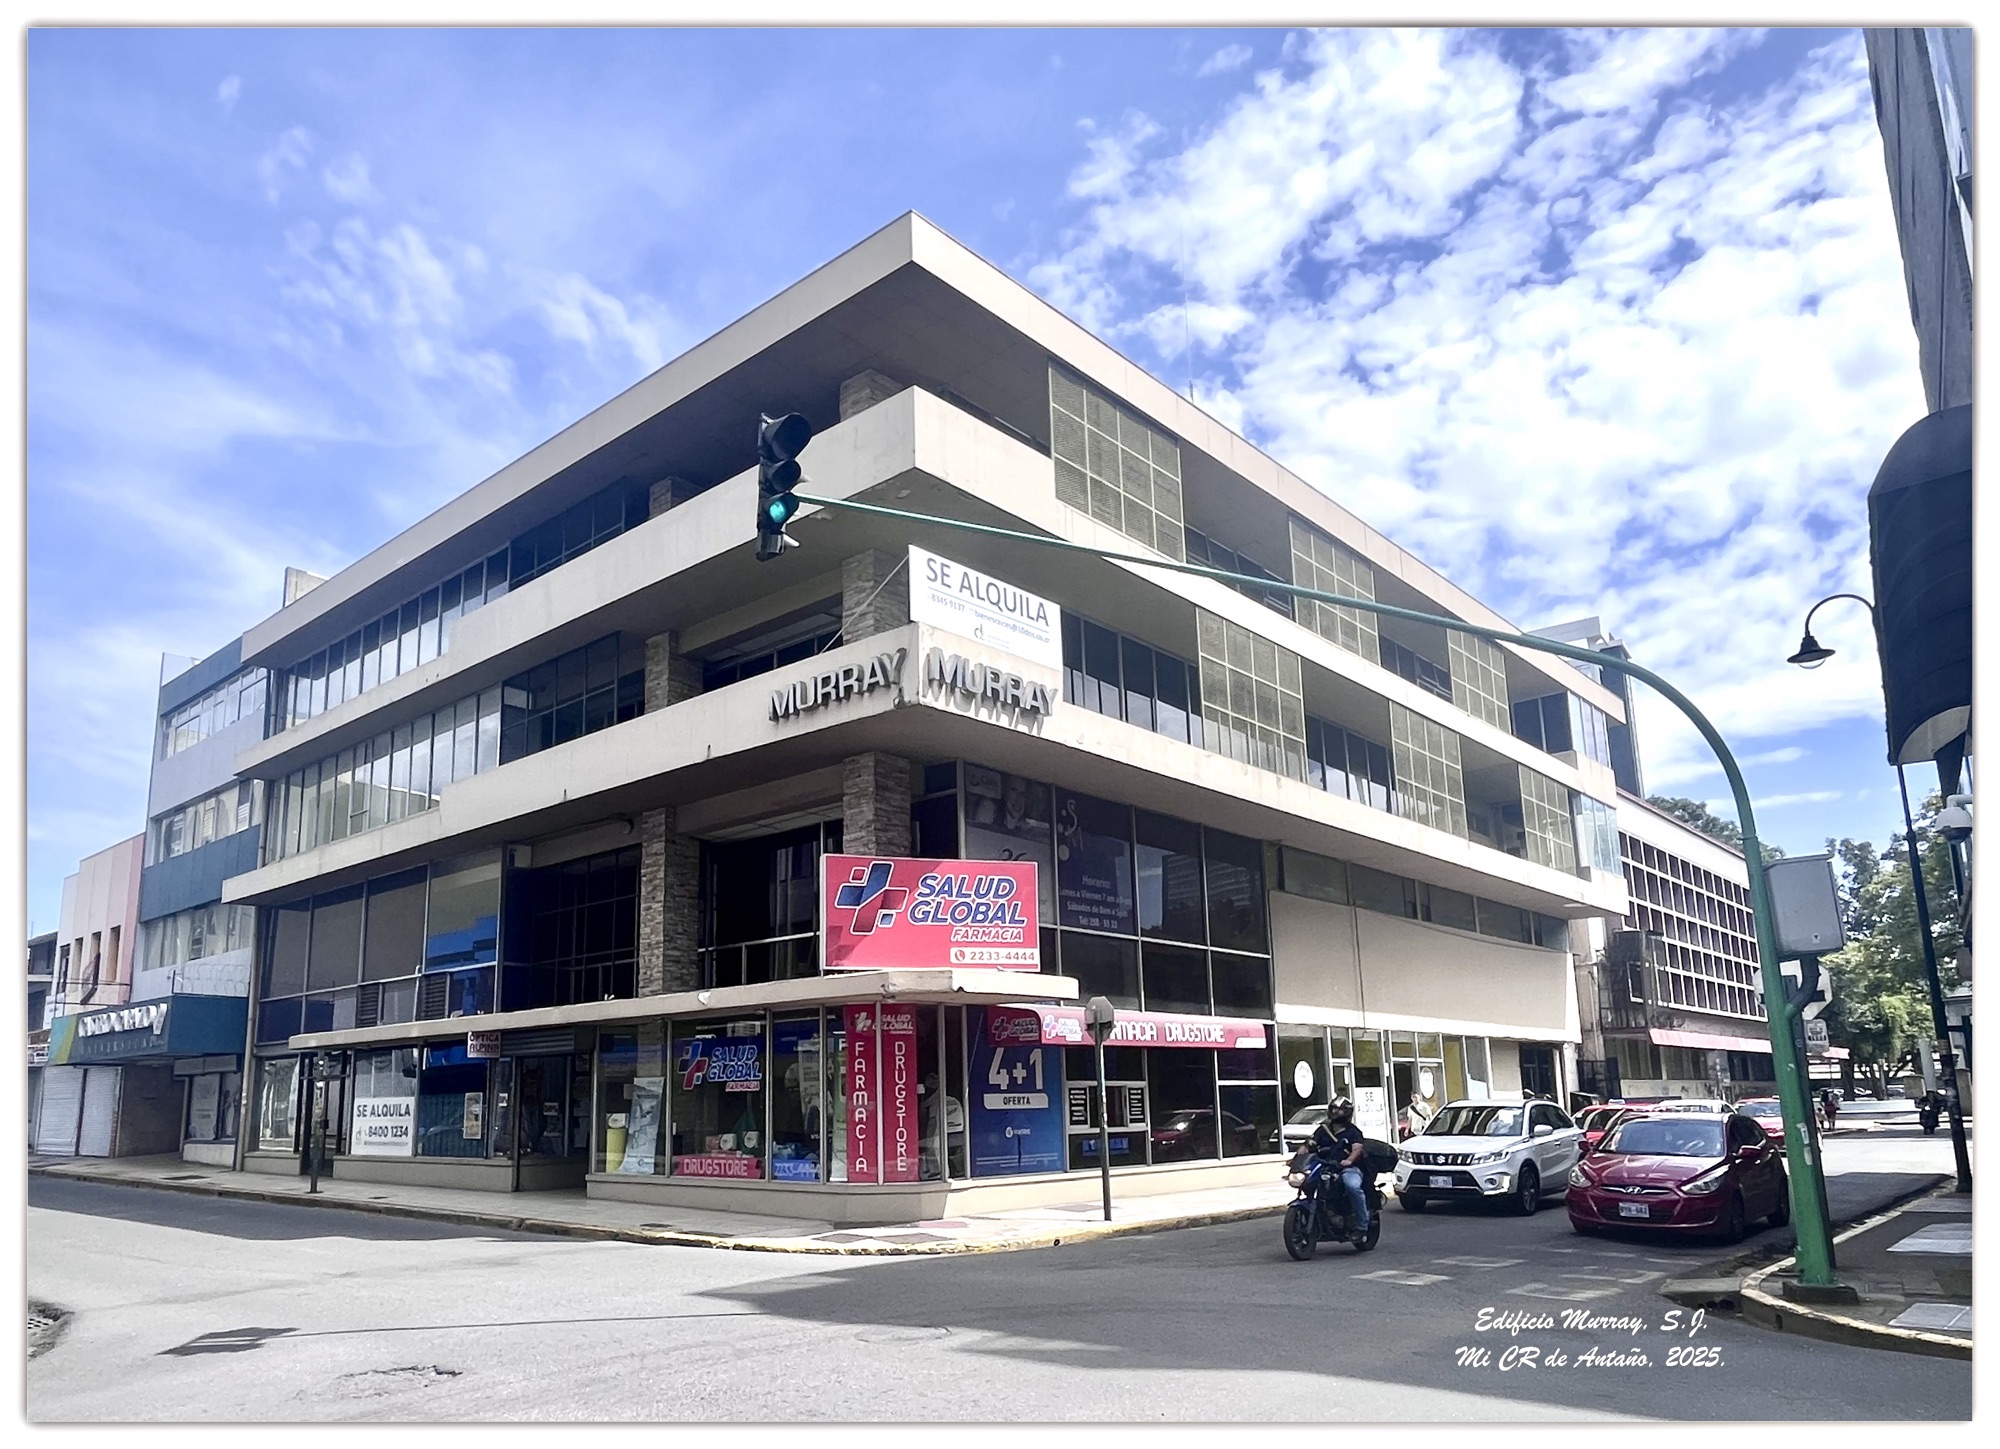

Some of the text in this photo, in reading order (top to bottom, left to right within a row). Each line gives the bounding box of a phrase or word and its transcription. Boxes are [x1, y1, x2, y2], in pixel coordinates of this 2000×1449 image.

[926, 557, 1050, 627] SE ALQUILA
[931, 593, 948, 607] 8345
[949, 600, 965, 612] 9137
[769, 647, 907, 723] MURRAY
[928, 646, 1059, 718] MURRAY
[915, 873, 1016, 900] SALUD
[908, 900, 1027, 925] GLOBAL
[951, 928, 1023, 942] FARMACIA
[970, 951, 1035, 961] 2233-4444
[881, 1014, 911, 1022] SALUD
[1010, 1018, 1037, 1026] SALUD
[1008, 1026, 1039, 1036] GLOBAL
[1165, 1022, 1226, 1043] DRUGSTORE
[711, 1045, 758, 1063] SALUD
[707, 1062, 762, 1082] GLOBAL
[988, 1047, 1044, 1090] 4+1
[1002, 1096, 1032, 1106] OFERTA
[1365, 1091, 1374, 1102] SE
[356, 1103, 411, 1118] SE ALQUILA
[853, 1041, 868, 1173] FARMACIA
[894, 1041, 908, 1172] DRUGSTORE
[368, 1126, 389, 1138] 8400
[391, 1125, 409, 1138] 1234
[683, 1158, 749, 1176] DRUGSTORE
